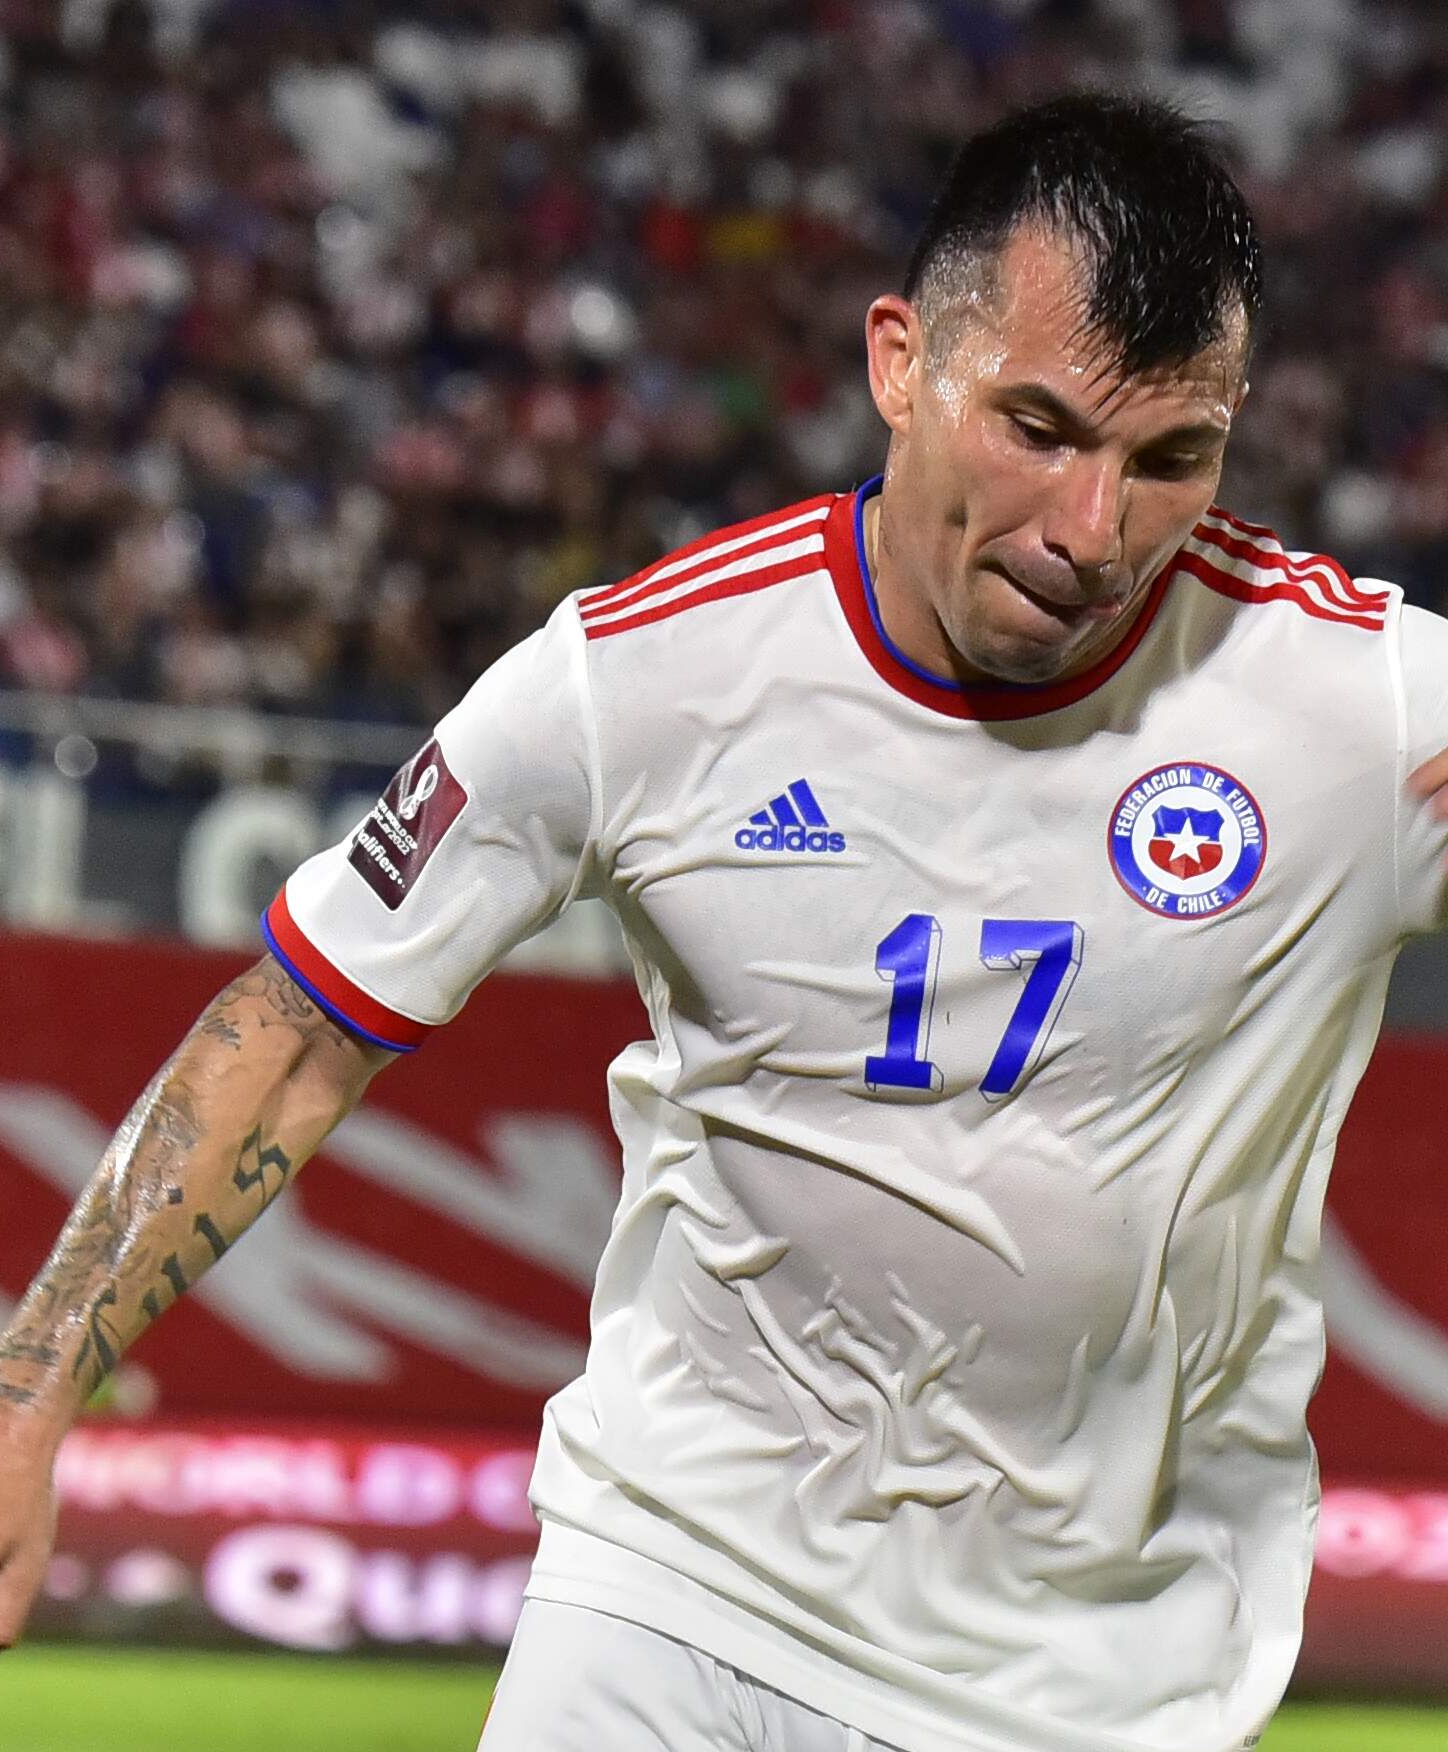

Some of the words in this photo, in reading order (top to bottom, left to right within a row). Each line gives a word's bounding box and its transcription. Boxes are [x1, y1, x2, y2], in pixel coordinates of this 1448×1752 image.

[1114, 768, 1191, 837] FEDERACION
[1202, 772, 1225, 792] DE
[1225, 789, 1260, 848] FUTBOL
[734, 822, 846, 853] adidas
[1145, 890, 1169, 908] DE
[1177, 890, 1224, 914] CHILE
[863, 911, 1085, 1102] 17
